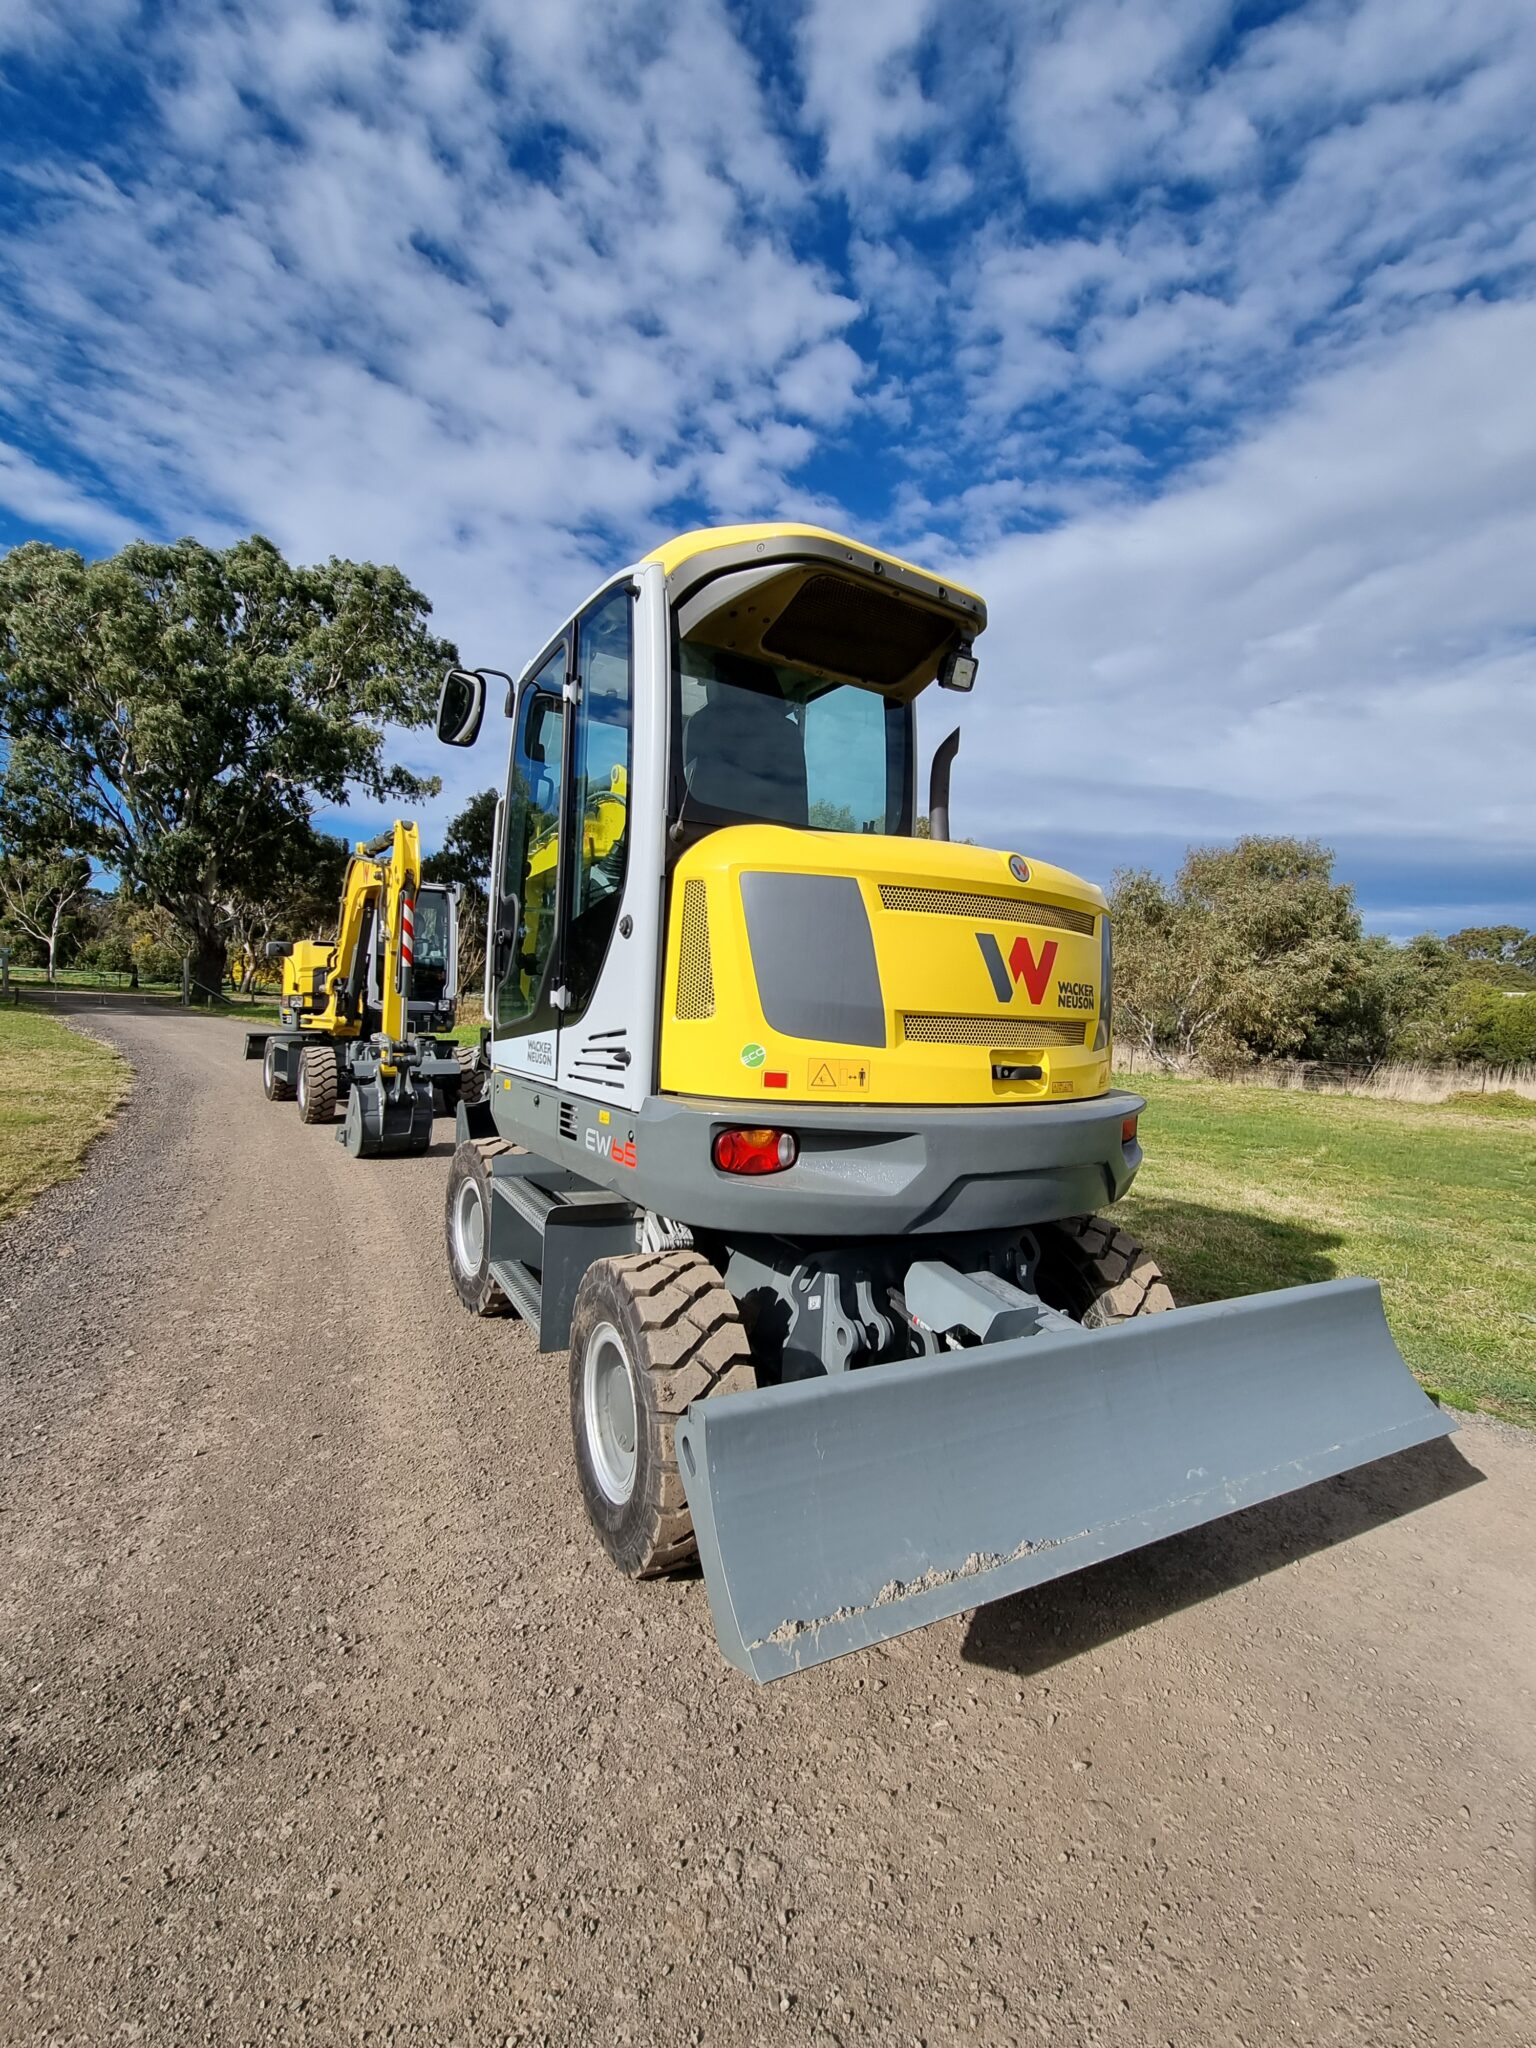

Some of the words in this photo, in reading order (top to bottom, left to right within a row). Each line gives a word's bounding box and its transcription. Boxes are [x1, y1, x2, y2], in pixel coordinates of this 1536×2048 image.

[1057, 980, 1094, 997] WACKER
[1057, 994, 1095, 1010] NEUSON
[527, 1039, 552, 1054] WACKER
[527, 1050, 552, 1066] NEUSON
[742, 1047, 765, 1064] ECO
